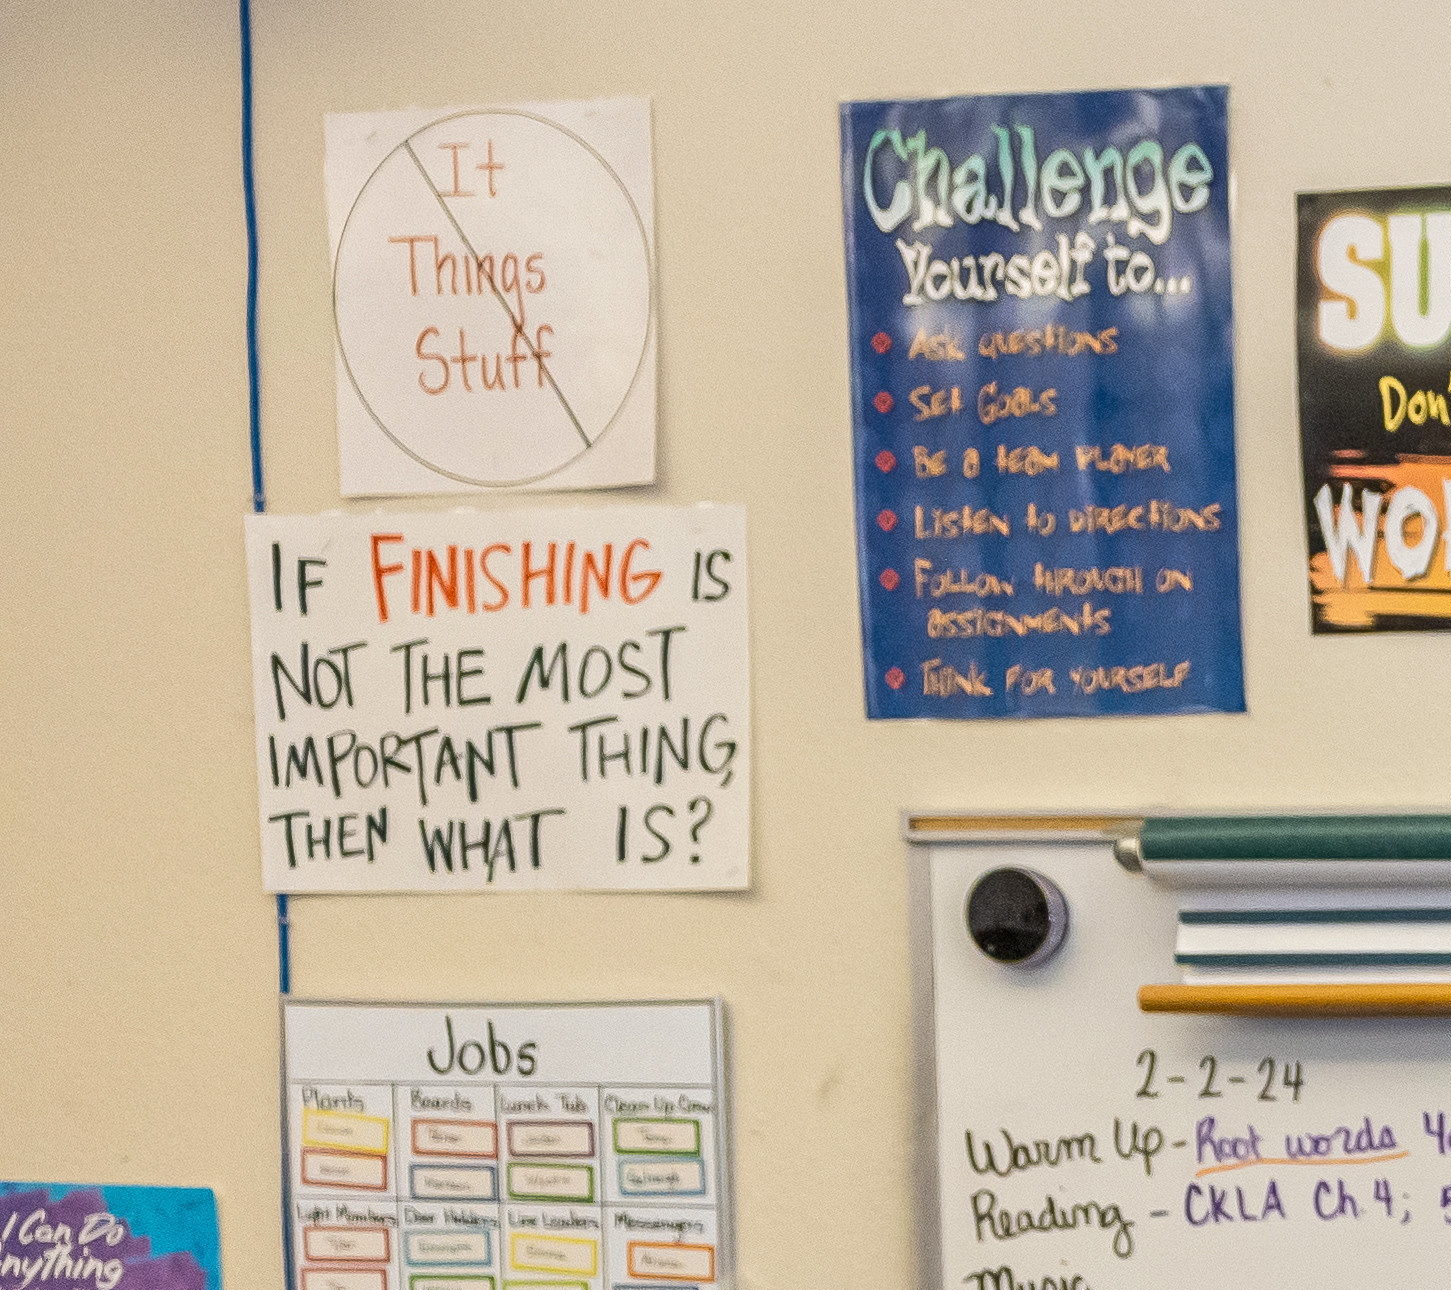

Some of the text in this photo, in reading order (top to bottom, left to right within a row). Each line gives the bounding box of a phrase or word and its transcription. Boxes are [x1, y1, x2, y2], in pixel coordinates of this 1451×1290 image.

[438, 138, 507, 199] It
[864, 124, 1213, 243] Challenge
[388, 233, 547, 330] Things
[896, 231, 1190, 305] Yourself to...
[415, 323, 554, 395] Stuff
[270, 533, 732, 622] IF FINISHING IS
[270, 627, 686, 719] NOT THE MOST
[268, 723, 542, 805] IMPORTANT
[268, 795, 713, 883] THEN WHAT IS?
[426, 1016, 538, 1076] Jobs
[1135, 1050, 1304, 1101] 2-2-24
[965, 1128, 1102, 1178] Warm
[1114, 1118, 1164, 1174] Up
[1196, 1115, 1262, 1162] Root
[1285, 1118, 1397, 1160] words
[19, 1208, 72, 1245] Can
[78, 1212, 124, 1246] Do
[971, 1190, 1135, 1258] Reading
[1184, 1179, 1286, 1226] CKLA
[0, 1238, 123, 1290] nything
